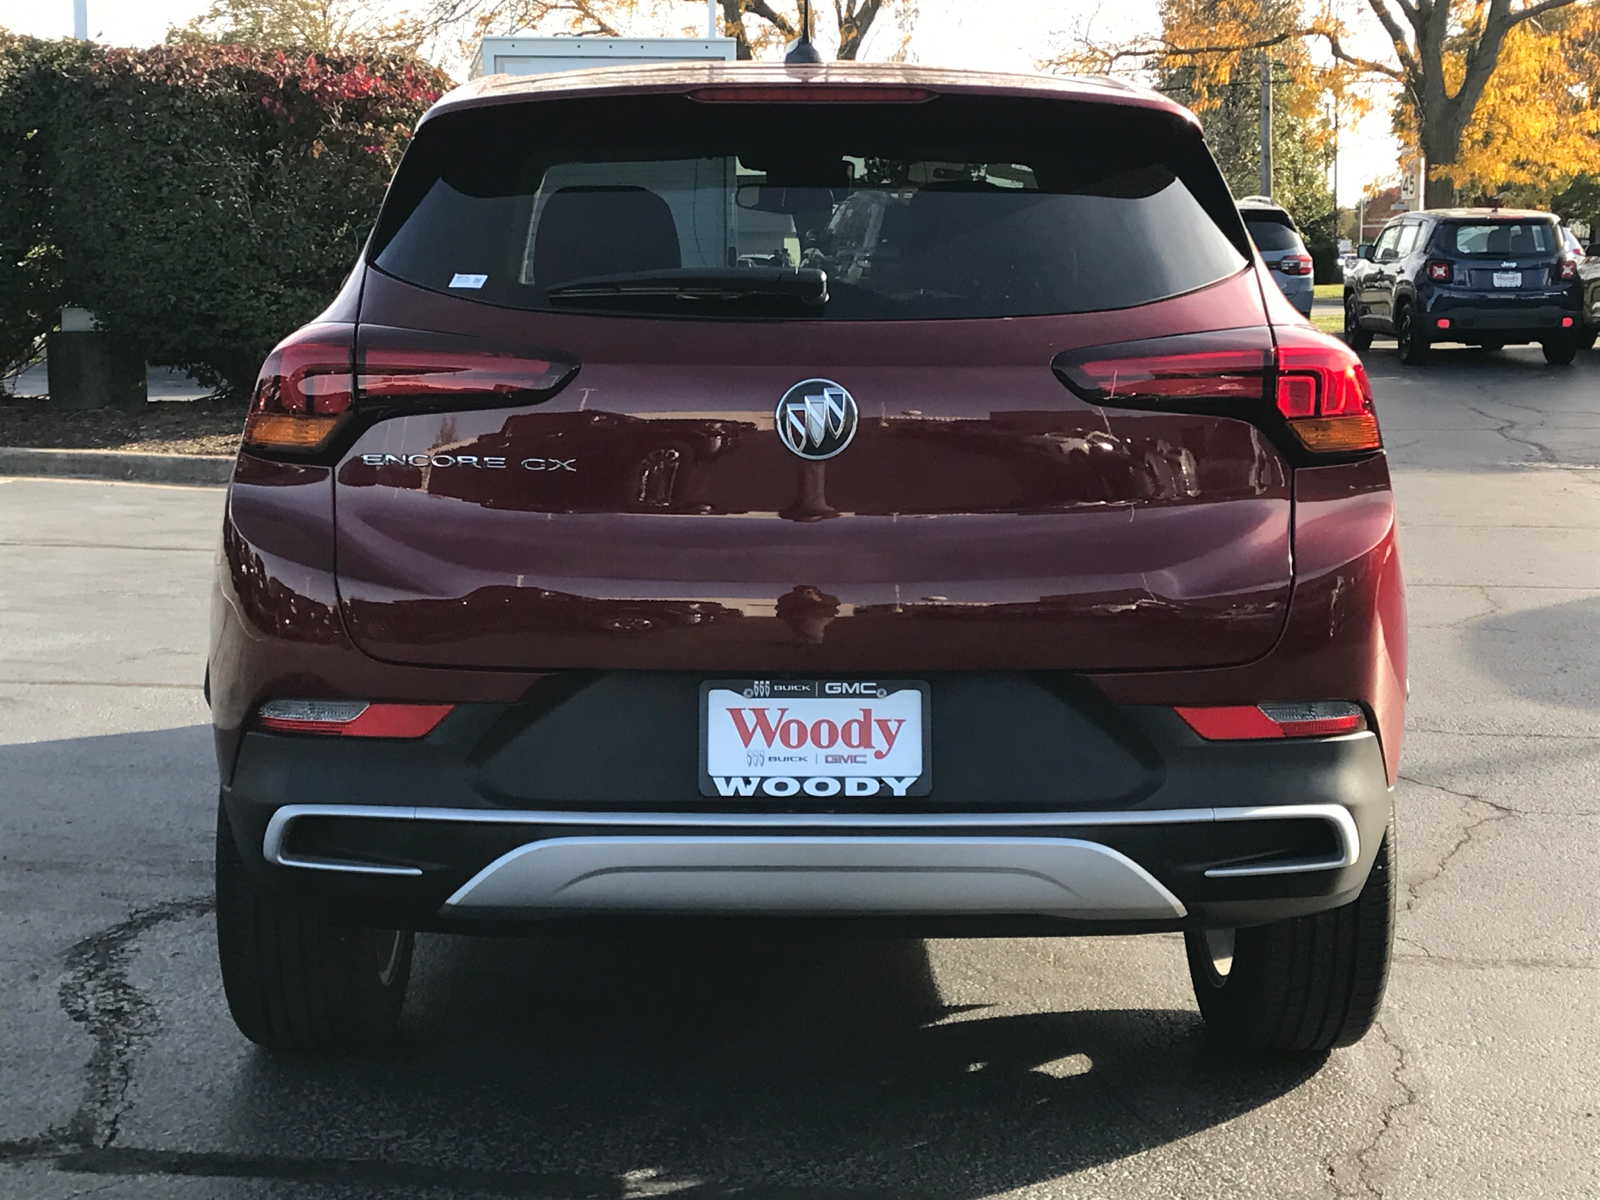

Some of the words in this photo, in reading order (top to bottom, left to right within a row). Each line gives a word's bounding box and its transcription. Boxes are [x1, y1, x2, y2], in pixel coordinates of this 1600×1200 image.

[1402, 174, 1415, 195] 45
[1501, 261, 1517, 269] Jeep
[362, 454, 507, 469] ENCORE
[521, 458, 577, 472] GX
[825, 682, 877, 695] GMC
[726, 707, 906, 760] Woody
[824, 754, 867, 764] GMC
[712, 776, 918, 797] WOODY
